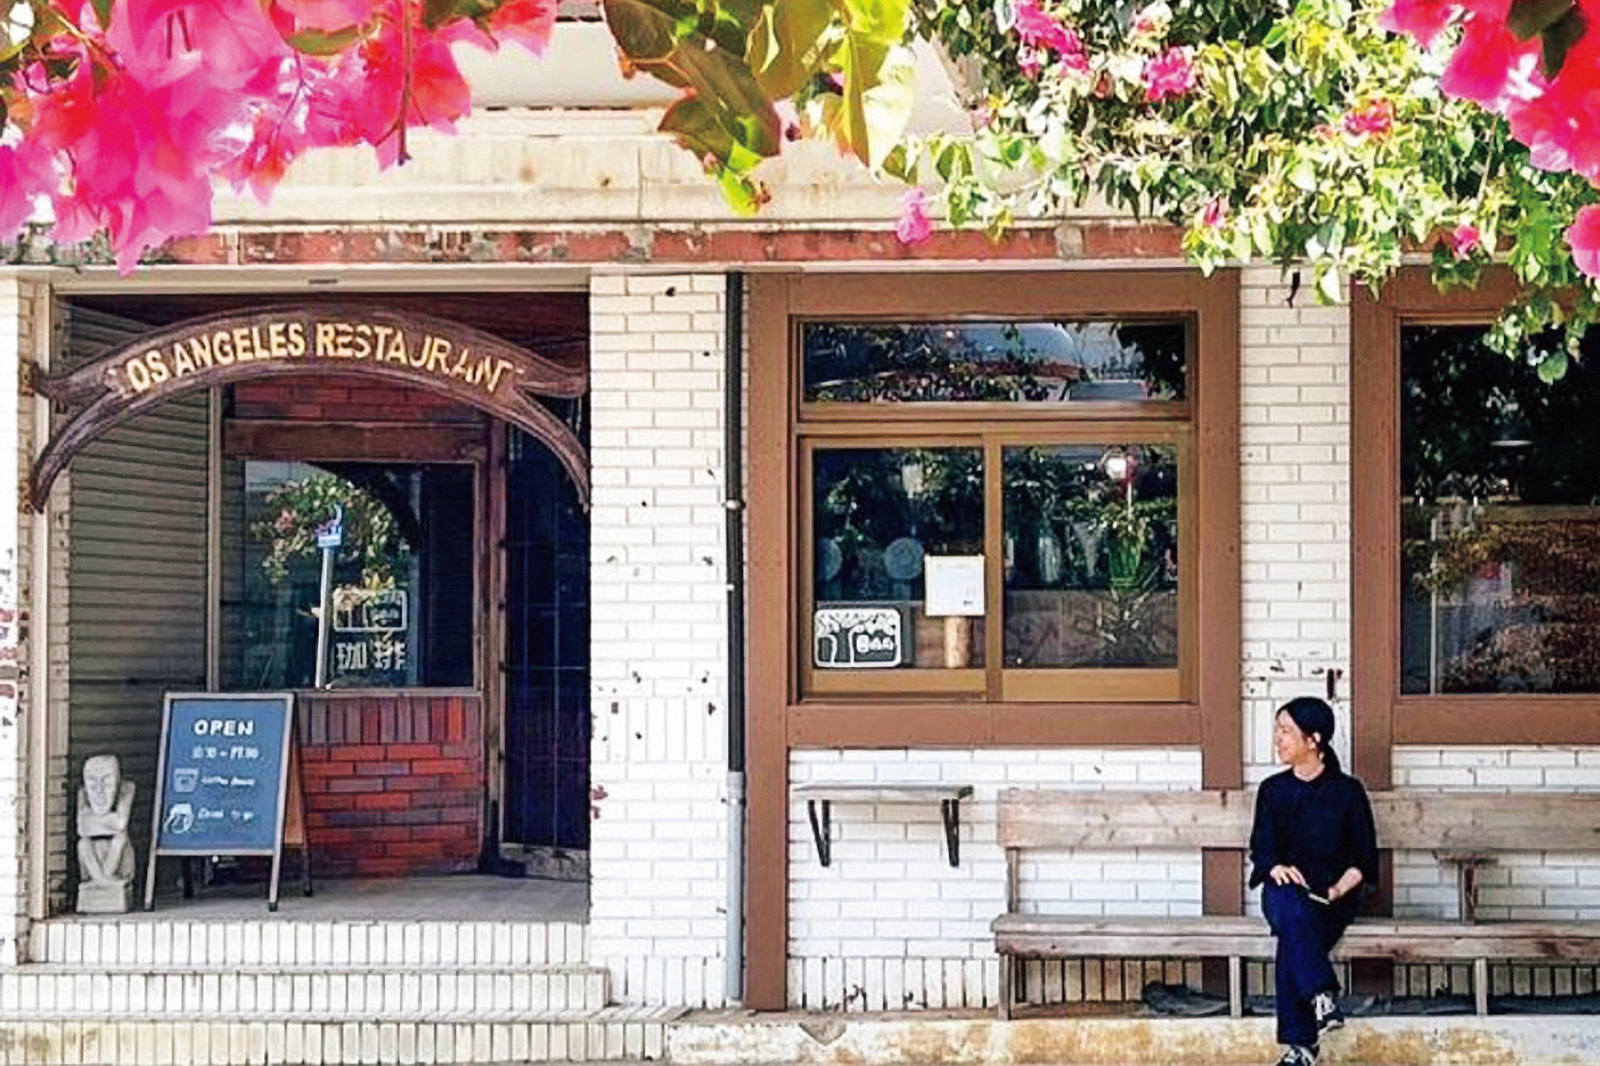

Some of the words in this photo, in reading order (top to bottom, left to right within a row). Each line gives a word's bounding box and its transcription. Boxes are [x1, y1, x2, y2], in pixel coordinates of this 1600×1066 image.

[110, 350, 170, 394] OS
[173, 323, 306, 378] ANGELES
[194, 719, 254, 737] OPEN
